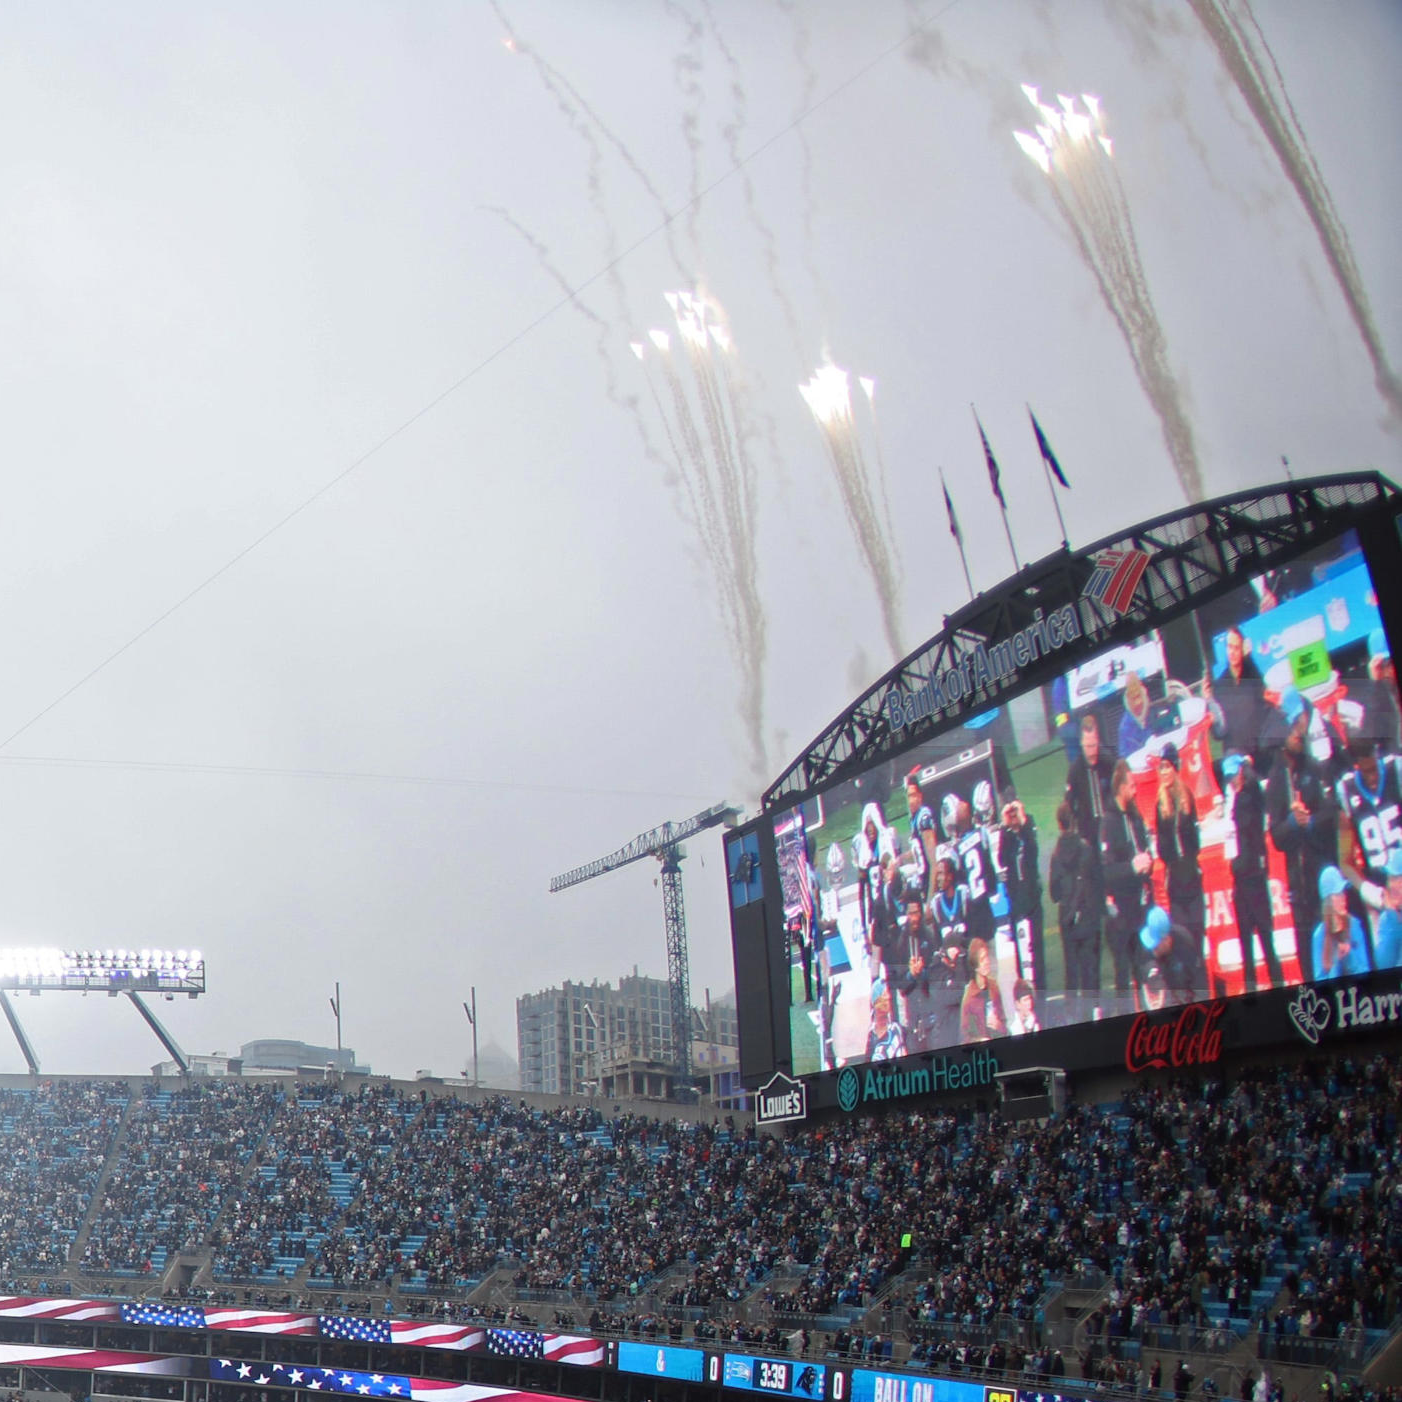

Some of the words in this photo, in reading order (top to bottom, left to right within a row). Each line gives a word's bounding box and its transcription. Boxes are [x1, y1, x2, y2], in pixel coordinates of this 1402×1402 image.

[886, 671, 946, 733] Bank
[946, 653, 973, 700] of
[973, 603, 1083, 689] America
[863, 1066, 930, 1102] Atrium
[933, 1048, 999, 1091] Health
[709, 1356, 719, 1381] 0
[760, 1362, 786, 1390] 3:39
[833, 1371, 843, 1400] 0
